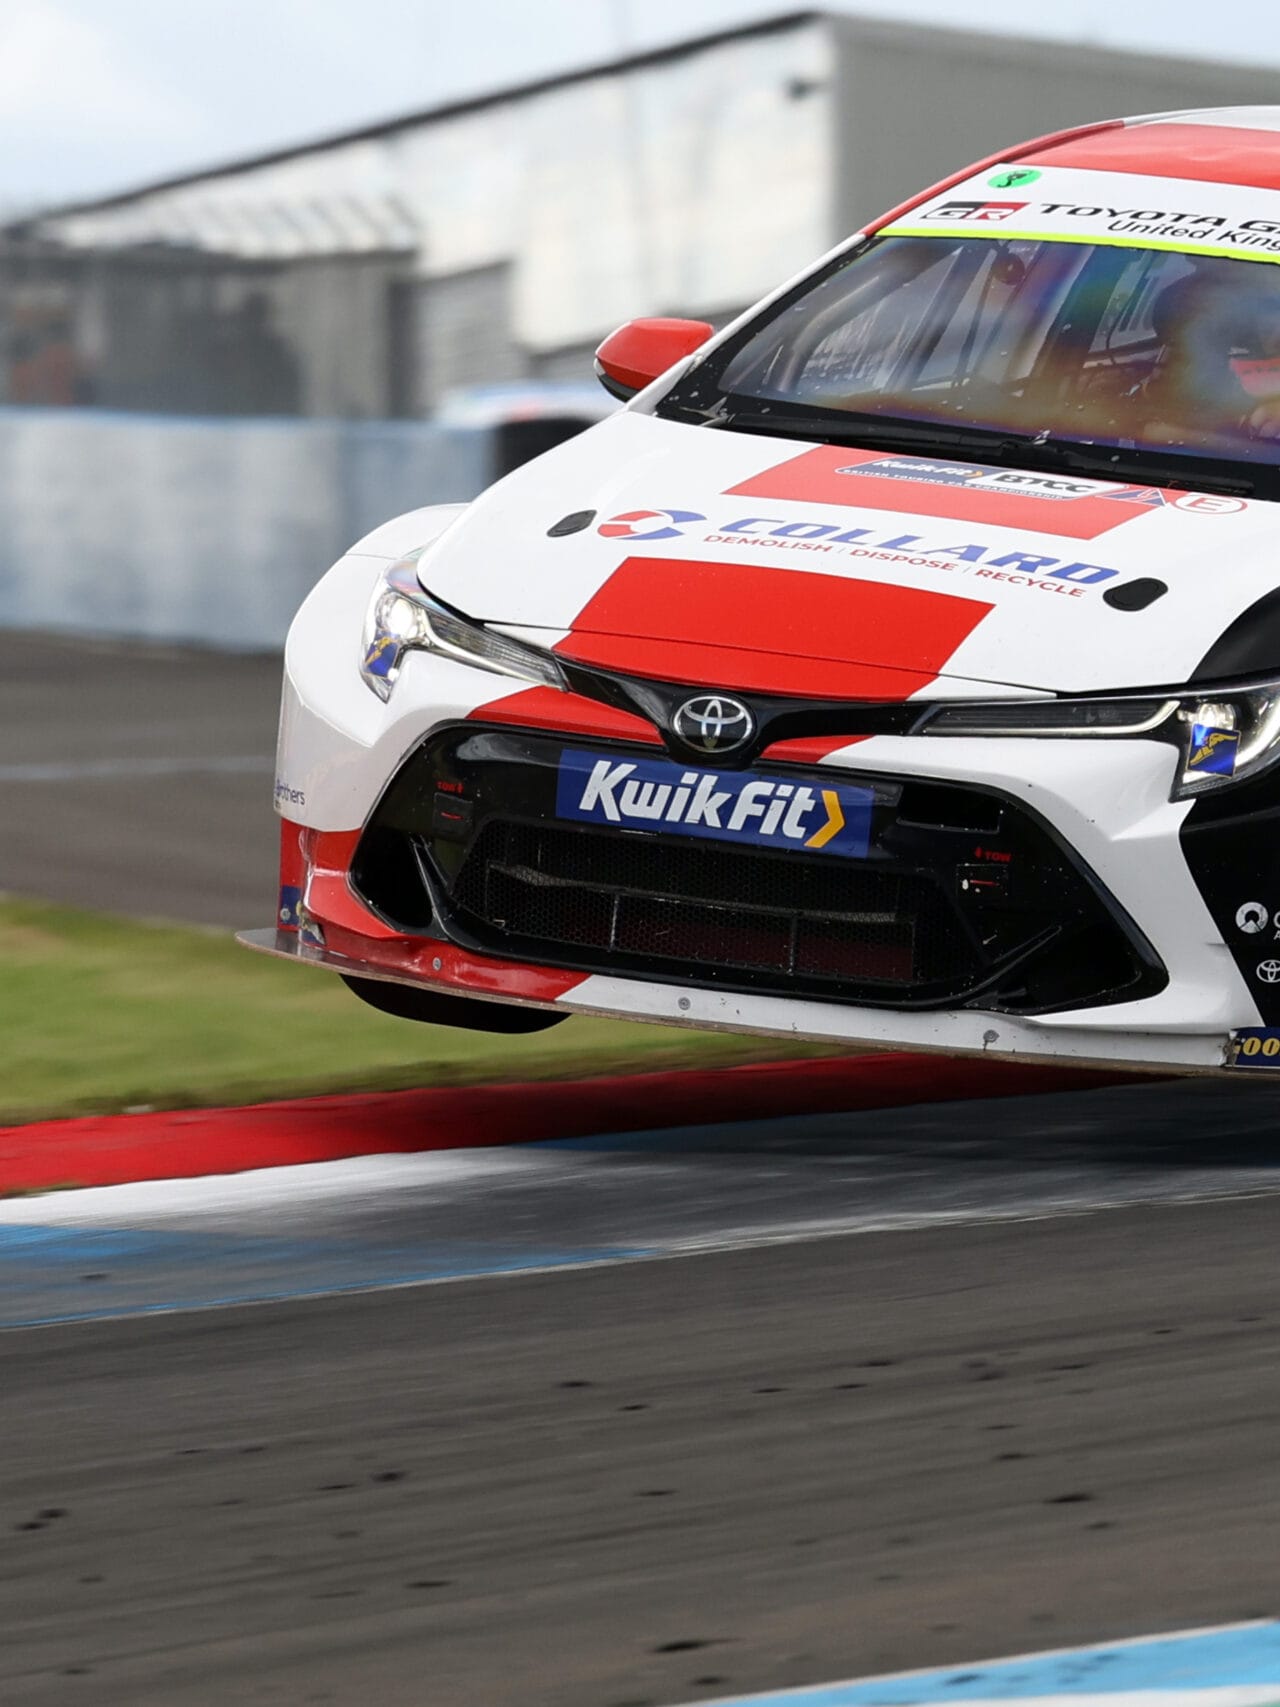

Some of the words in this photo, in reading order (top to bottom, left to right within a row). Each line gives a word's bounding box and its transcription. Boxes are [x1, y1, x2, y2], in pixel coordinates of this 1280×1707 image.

[921, 208, 1014, 220] GR
[1040, 202, 1228, 228] TOYOTA
[1106, 219, 1215, 240] United
[993, 474, 1096, 493] BTCC
[1185, 496, 1232, 512] E
[718, 517, 1121, 585] COLLARD
[703, 534, 835, 553] DEMOLISH
[849, 548, 960, 572] DISPOSE
[974, 568, 1087, 598] RECYCLE
[985, 851, 1012, 863] TOW
